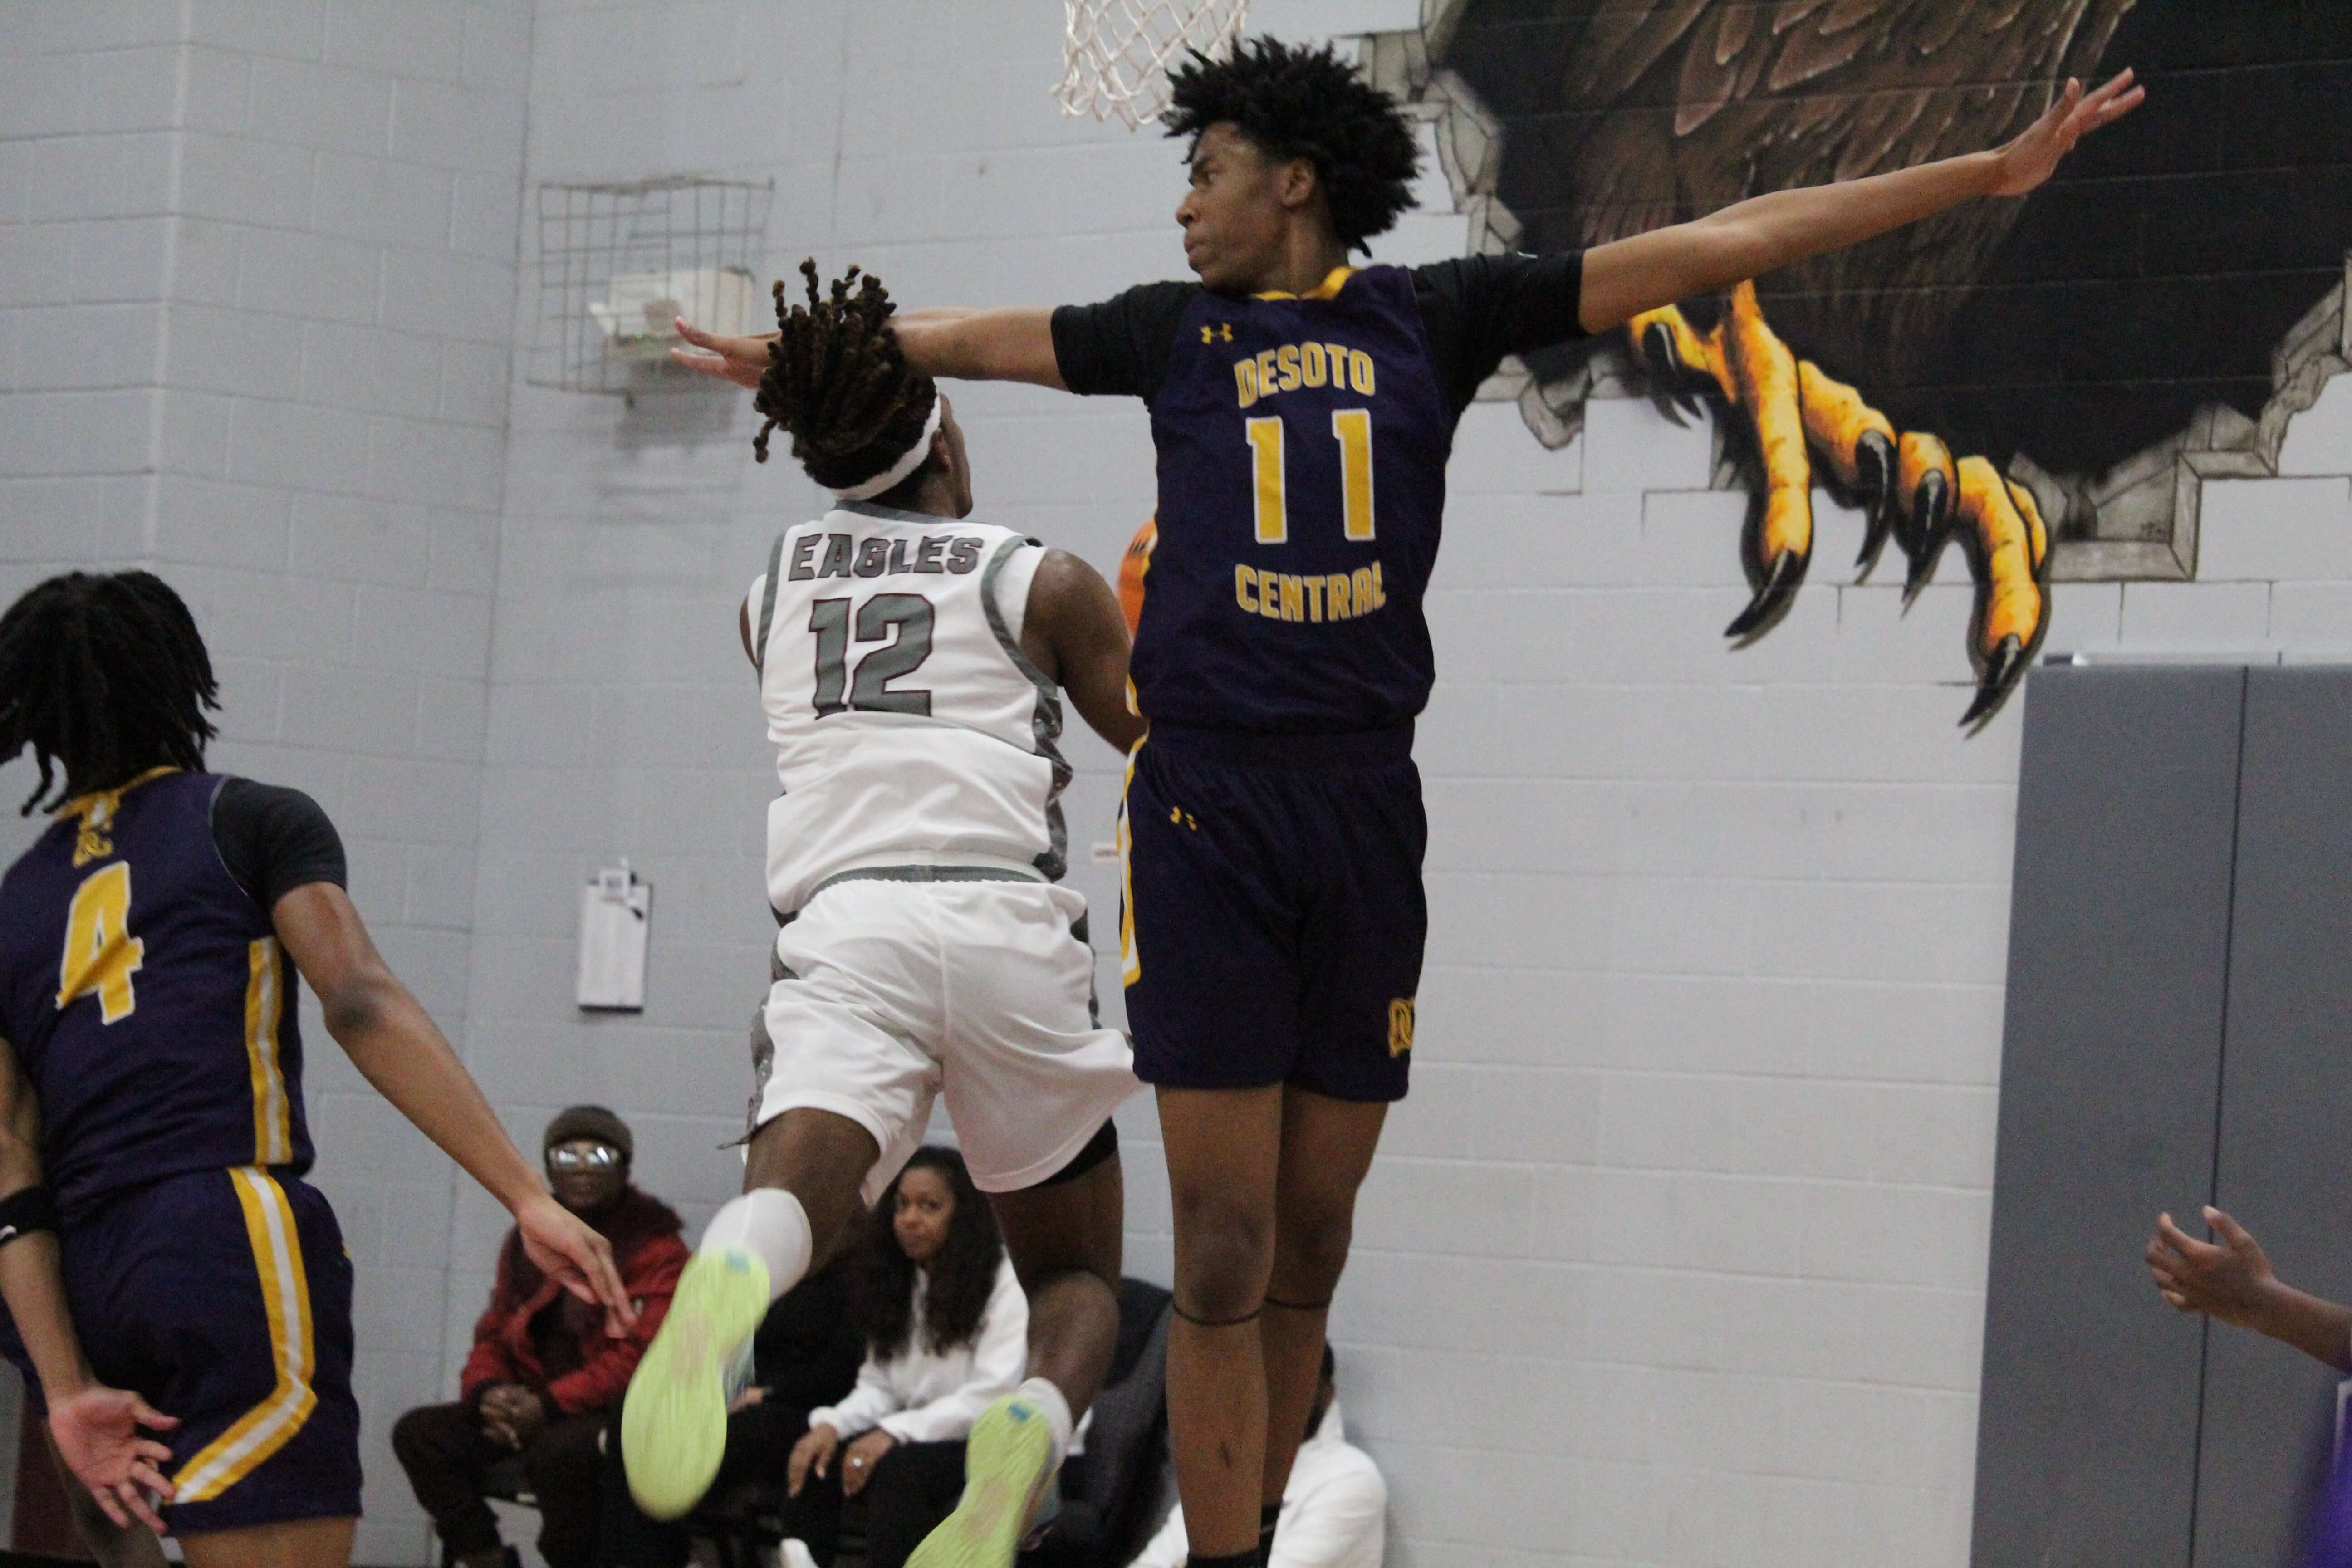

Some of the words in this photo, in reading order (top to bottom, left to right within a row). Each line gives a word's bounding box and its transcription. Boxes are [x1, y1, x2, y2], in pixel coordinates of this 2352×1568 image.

[1233, 341, 1376, 408] DESOTO
[1246, 408, 1376, 544] 11
[788, 533, 984, 582] EAGLES
[1234, 560, 1386, 623] CENTRAL
[808, 592, 935, 720] 12
[55, 860, 145, 1026] 4
